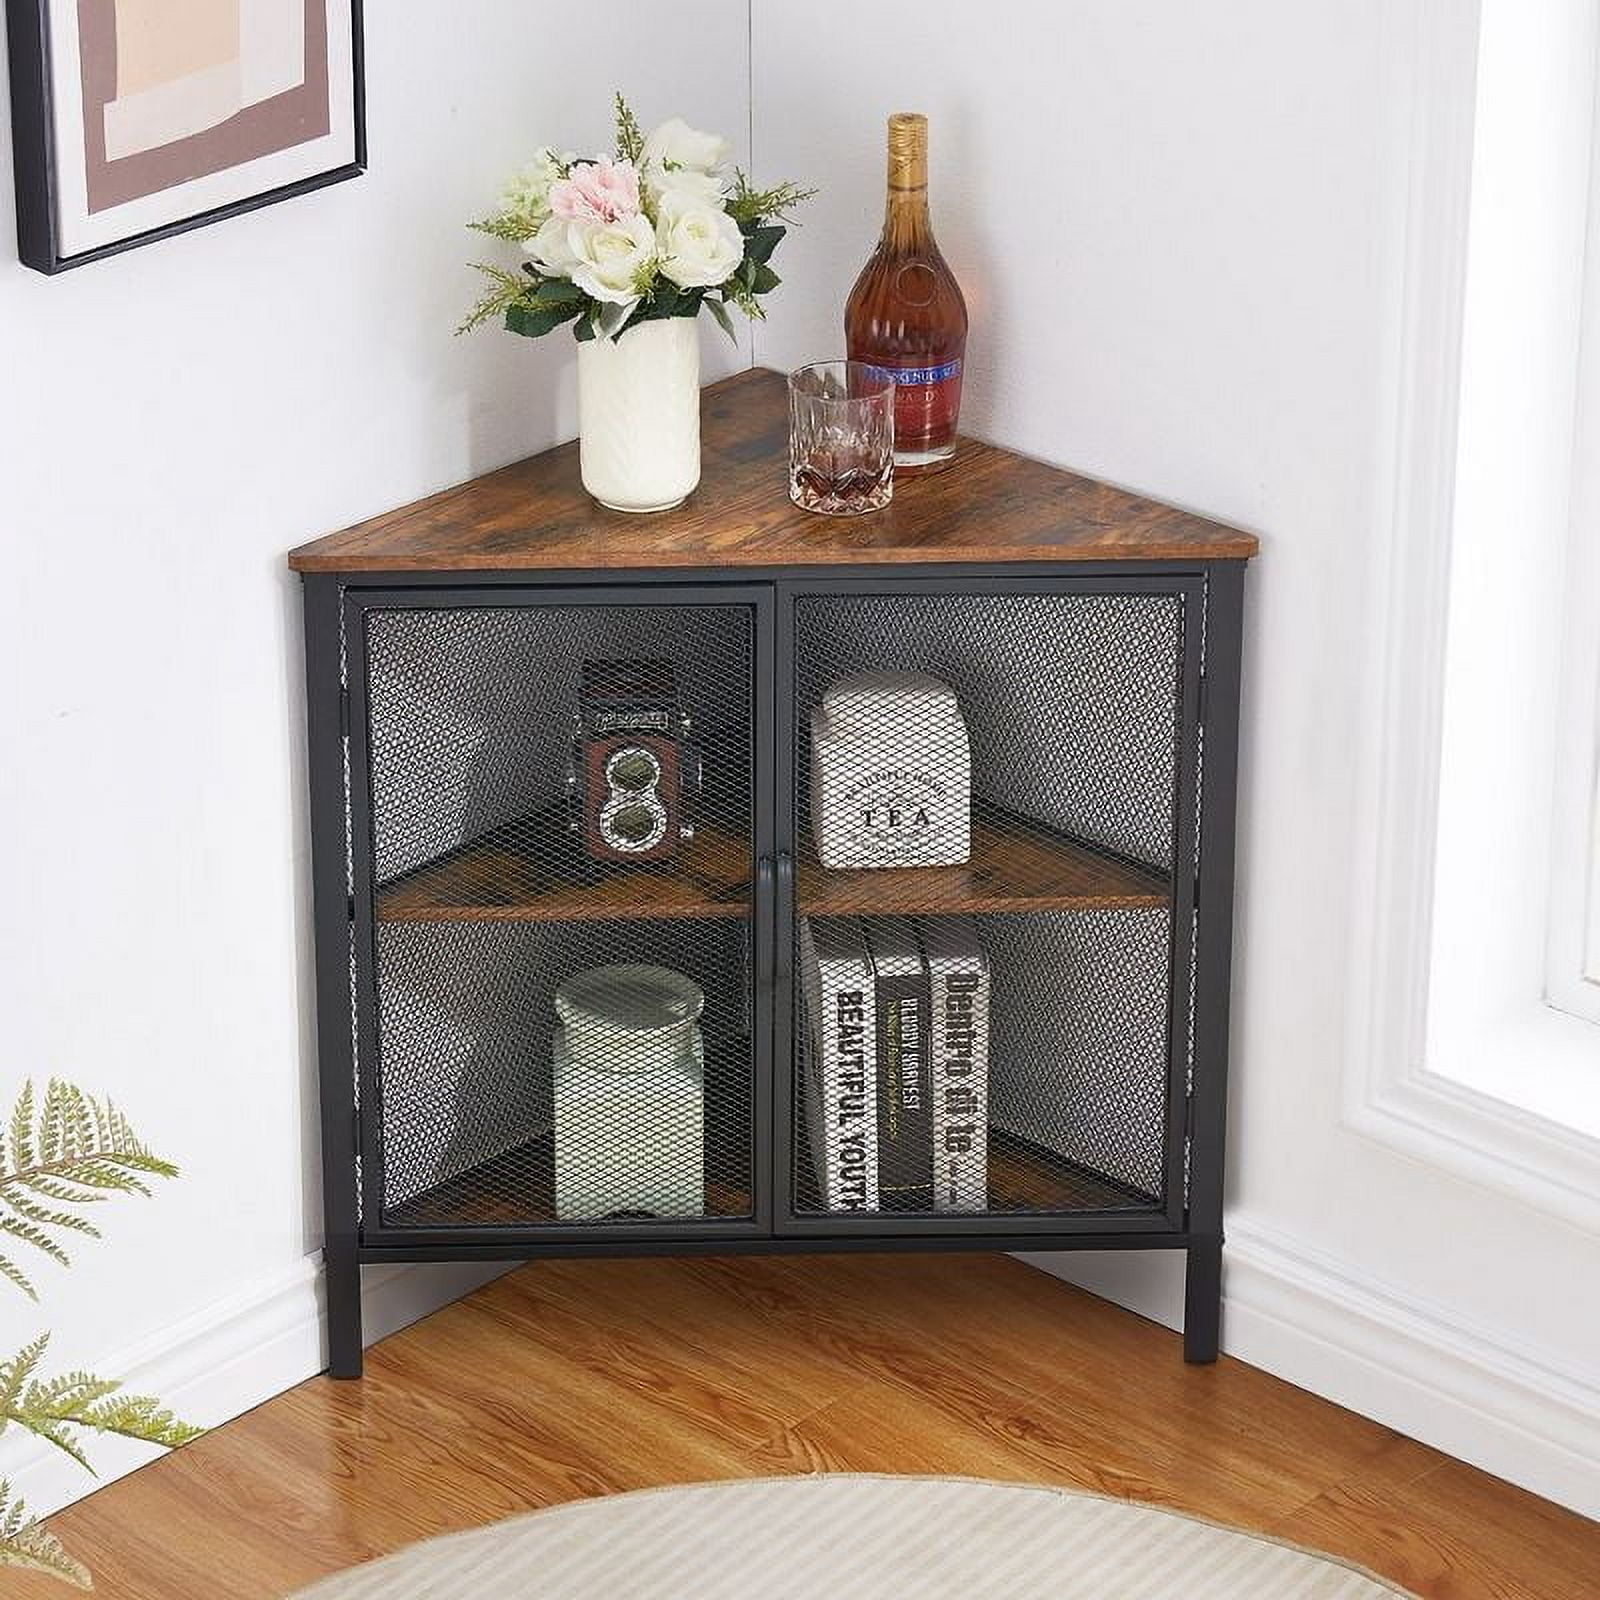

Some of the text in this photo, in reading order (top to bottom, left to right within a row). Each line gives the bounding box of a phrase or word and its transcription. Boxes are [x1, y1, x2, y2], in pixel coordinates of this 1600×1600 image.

[860, 809, 930, 828] TEA
[837, 991, 866, 1127] BEAUTIFUL
[901, 998, 920, 1110] BLOODY HARVEST
